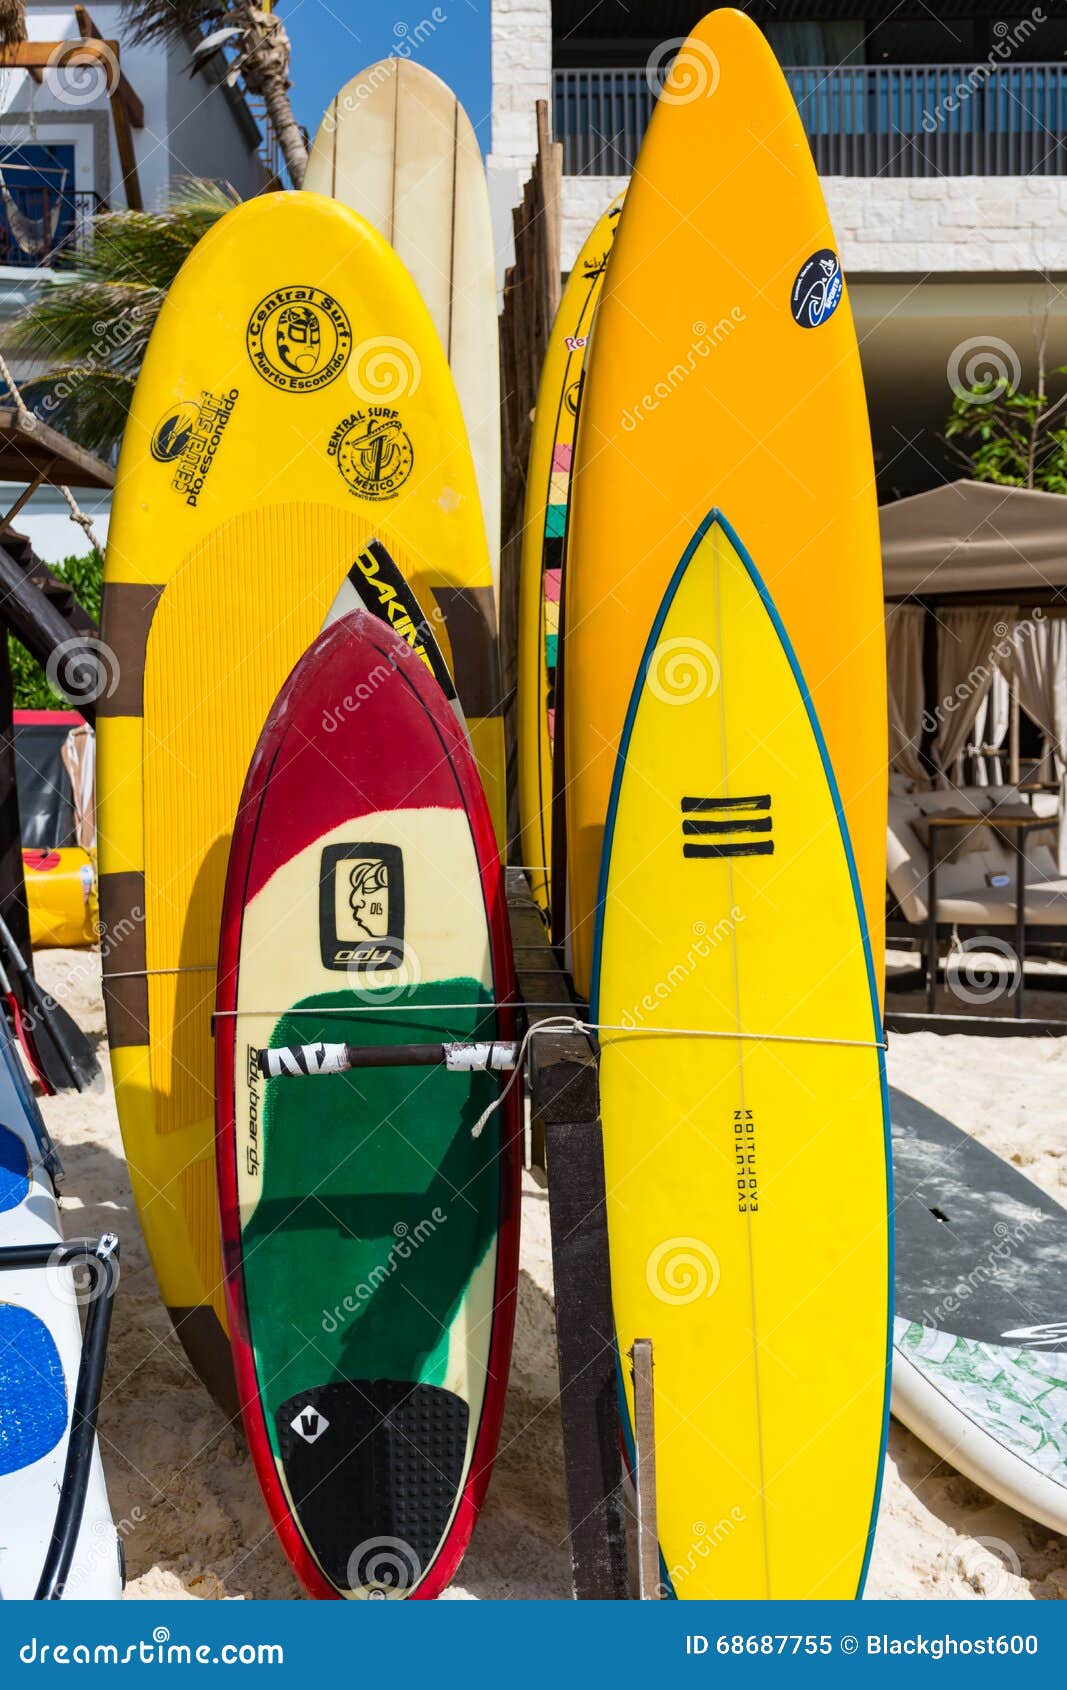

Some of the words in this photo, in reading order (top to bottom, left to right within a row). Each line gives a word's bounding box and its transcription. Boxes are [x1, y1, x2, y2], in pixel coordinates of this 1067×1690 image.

[250, 289, 316, 336] Central
[320, 297, 350, 338] Surf
[564, 336, 589, 351] Re
[254, 352, 286, 385] Puerto
[289, 353, 344, 388] Escondido
[186, 389, 239, 507] pto.escondido
[327, 410, 366, 456] CENTRAL
[367, 407, 399, 419] SURF
[333, 947, 393, 964] ody
[246, 1043, 260, 1176] odyboards
[734, 1110, 747, 1212] EVOLUTION
[300, 1415, 319, 1436] V
